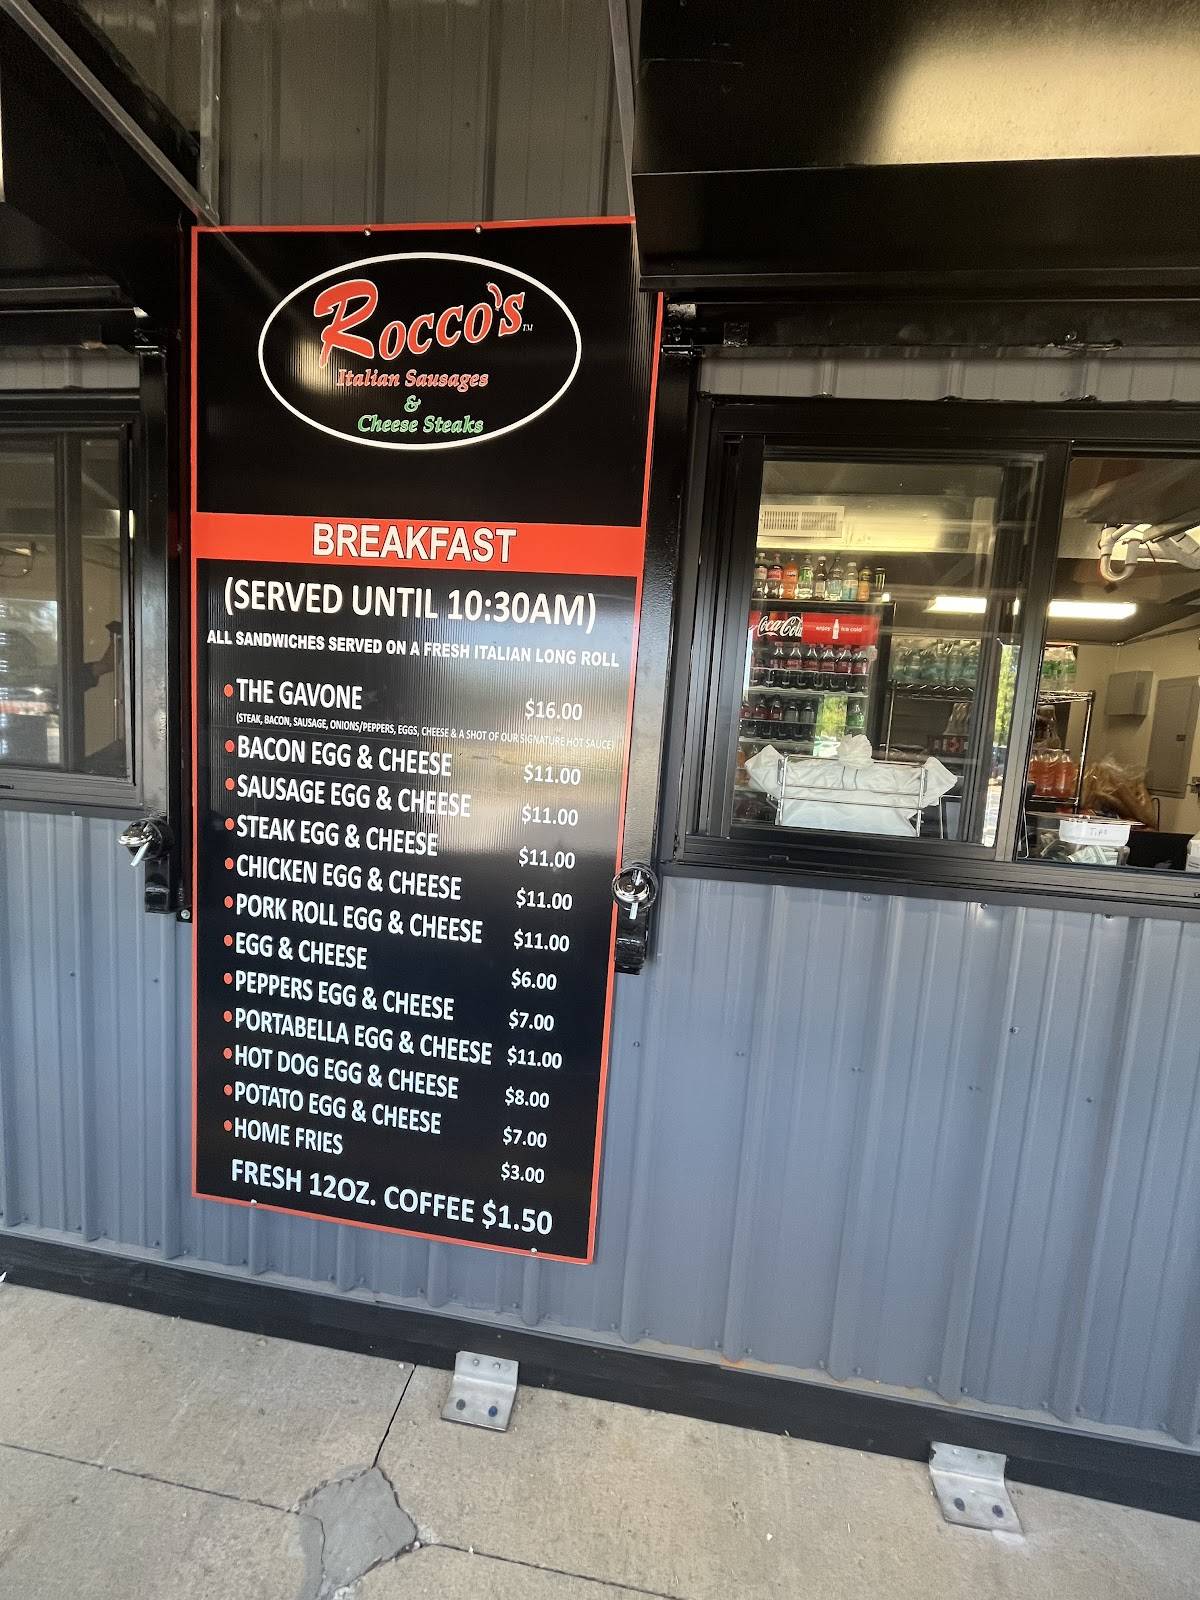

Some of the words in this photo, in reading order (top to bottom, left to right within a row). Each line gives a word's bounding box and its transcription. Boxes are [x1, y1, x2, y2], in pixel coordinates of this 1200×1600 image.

[336, 369, 400, 387] Italian
[404, 370, 489, 392] Sausages
[404, 396, 421, 412] &
[357, 415, 418, 434] Cheese
[423, 415, 484, 434] Steaks
[312, 522, 517, 563] BREAKFAST
[225, 576, 343, 615] (SERVED
[352, 585, 438, 619] UNTIL
[447, 589, 596, 634] 10:30AM)
[207, 630, 233, 645] ALL
[236, 631, 325, 650] SANDWICHES
[328, 636, 382, 653] SERVED
[386, 640, 406, 655] ON
[410, 643, 420, 656] A
[424, 642, 469, 659] FRESH
[474, 645, 531, 662] ITALIAN
[535, 649, 576, 665] LONG
[581, 652, 619, 668] ROLL
[236, 678, 274, 703] THE
[279, 681, 362, 710] GAVONE
[525, 698, 583, 721] $16.00
[236, 712, 263, 725] (STEAK,
[264, 714, 292, 727] BACON,
[293, 716, 328, 730] SAUSAGE,
[330, 720, 396, 735] ONIONS/PEPPERS,
[398, 725, 419, 737] EGGS,
[421, 727, 450, 737] CHEESE
[450, 729, 457, 738] &
[458, 729, 465, 738] A
[466, 730, 487, 741] SHOT
[488, 731, 499, 742] OF
[501, 732, 519, 743] OUR
[520, 733, 565, 746] SIGNATURE
[566, 737, 584, 748] HOT
[237, 735, 305, 763] BACON
[311, 742, 351, 767] EGG
[356, 745, 373, 770] &
[378, 748, 452, 777] CHEESE
[523, 763, 581, 786] $11.00
[237, 774, 325, 805] SAUSAGE
[330, 782, 370, 808] EGG
[375, 784, 392, 811] &
[398, 788, 471, 818] CHEESE
[521, 804, 578, 826] $11.00
[237, 814, 295, 842] STEAK
[300, 821, 339, 847] EGG
[344, 824, 360, 849] &
[365, 826, 438, 857] CHEESE
[518, 847, 575, 869] $11.00
[236, 854, 316, 884] CHICKEN
[322, 864, 362, 890] EGG
[367, 867, 383, 892] &
[388, 870, 461, 900] CHEESE
[516, 888, 573, 911] $11.00
[236, 893, 286, 920] PORK
[291, 900, 338, 927] ROLL
[343, 906, 381, 932] EGG
[387, 909, 403, 935] &
[409, 913, 483, 944] CHEESE
[513, 929, 570, 952] $11.00
[235, 931, 273, 957] EGG
[278, 935, 293, 960] &
[299, 939, 367, 970] CHEESE
[511, 968, 557, 991] $6.00
[235, 970, 313, 1001] PEPPERS
[318, 982, 356, 1008] EGG
[361, 986, 377, 1010] &
[383, 989, 454, 1021] CHEESE
[508, 1009, 554, 1032] $7.00
[235, 1008, 349, 1045] PORTABELLA
[354, 1024, 393, 1051] EGG
[399, 1030, 414, 1055] &
[420, 1034, 492, 1065] CHEESE
[507, 1046, 562, 1070] $11.00
[235, 1044, 273, 1070] HOT
[277, 1050, 319, 1078] DOG
[324, 1058, 362, 1084] EGG
[367, 1063, 382, 1088] &
[388, 1068, 459, 1100] CHEESE
[504, 1086, 549, 1109] $8.00
[234, 1081, 303, 1111] POTATO
[308, 1092, 346, 1119] EGG
[351, 1098, 366, 1123] &
[372, 1102, 441, 1135] CHEESE
[502, 1126, 547, 1149] $7.00
[234, 1117, 290, 1145] HOME
[295, 1126, 343, 1155] FRIES
[501, 1162, 545, 1184] $3.00
[231, 1158, 301, 1192] FRESH
[309, 1172, 376, 1206] 12OZ.
[384, 1185, 474, 1223] COFFEE
[481, 1199, 552, 1235] $1.50
